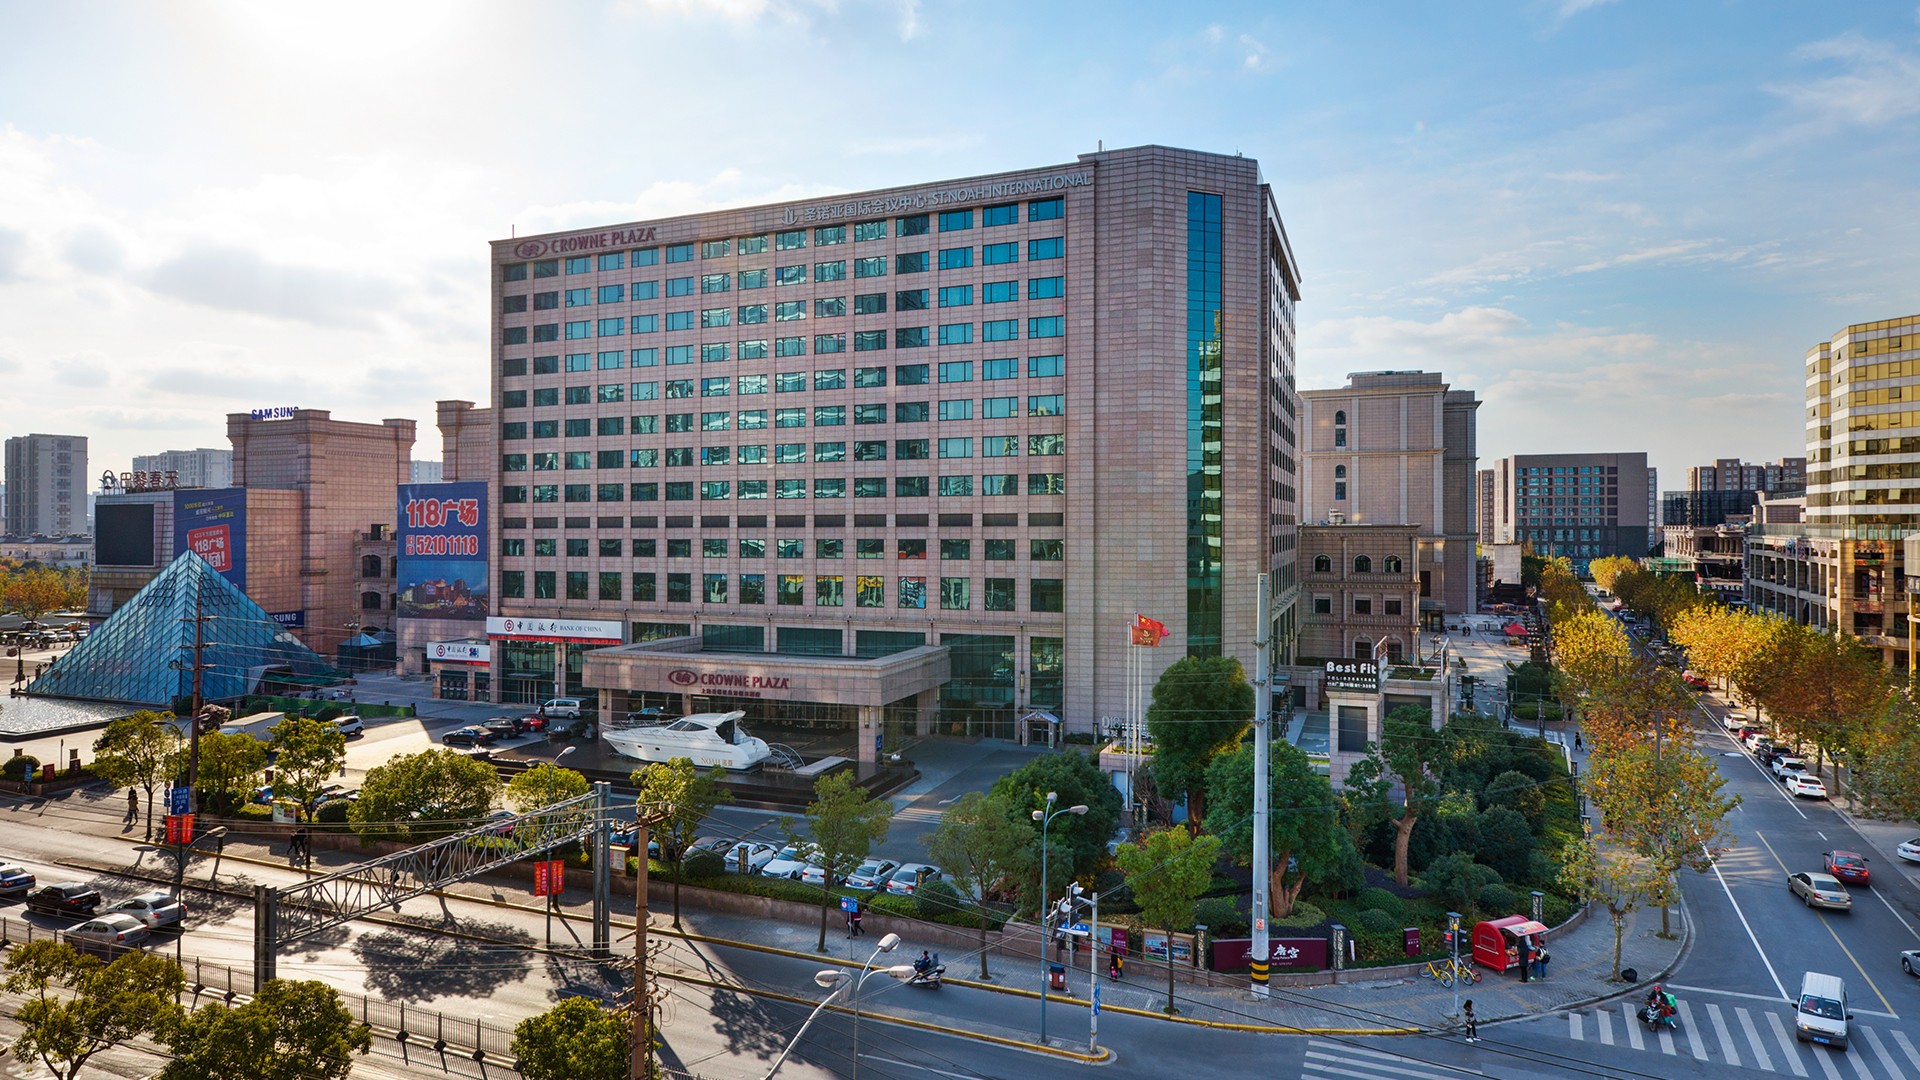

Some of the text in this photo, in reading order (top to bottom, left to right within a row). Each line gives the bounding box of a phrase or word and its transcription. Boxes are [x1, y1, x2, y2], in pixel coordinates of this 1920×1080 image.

[804, 172, 1091, 222] 圣诺亚国际会议中心 ST.NOAH INTERNATIONAL
[551, 227, 656, 253] CROWNE PLAZA
[251, 407, 299, 420] SAMSUN
[120, 470, 179, 488] 巴黎春天
[406, 498, 478, 527] 118广场
[195, 538, 224, 552] 118广场
[517, 622, 557, 633] 中国银行
[559, 624, 574, 632] BANK
[1326, 661, 1377, 675] Best Fit
[701, 674, 788, 689] CROWNE PLAZA
